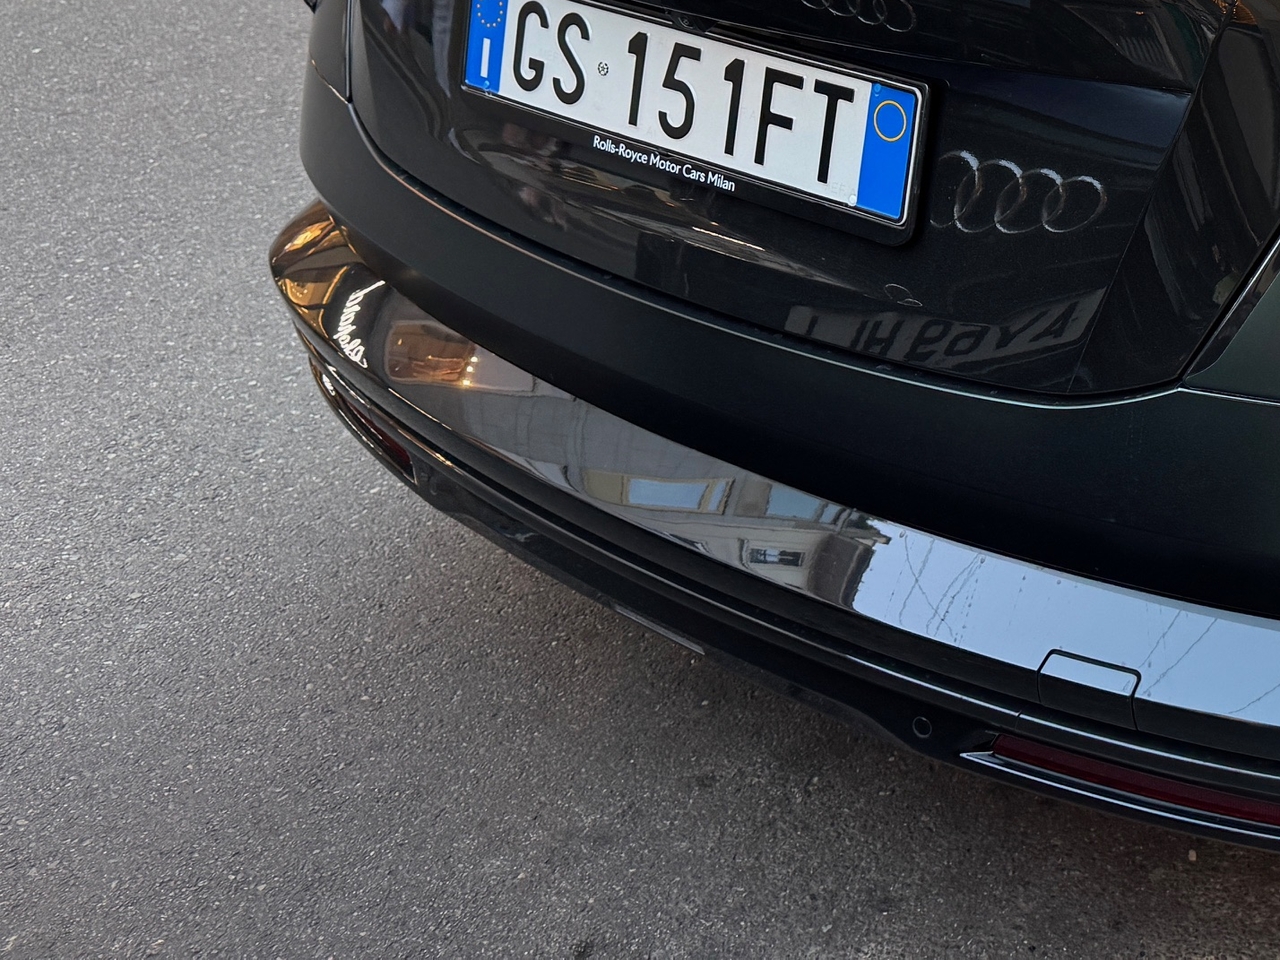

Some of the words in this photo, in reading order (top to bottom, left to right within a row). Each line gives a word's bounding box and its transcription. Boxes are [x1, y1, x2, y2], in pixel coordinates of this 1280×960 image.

[513, 0, 591, 105] GS
[627, 31, 856, 184] 151FT
[593, 135, 648, 164] Rolls-Royce
[649, 153, 681, 174] Motor
[682, 164, 706, 183] Cars
[707, 171, 736, 192] Milan
